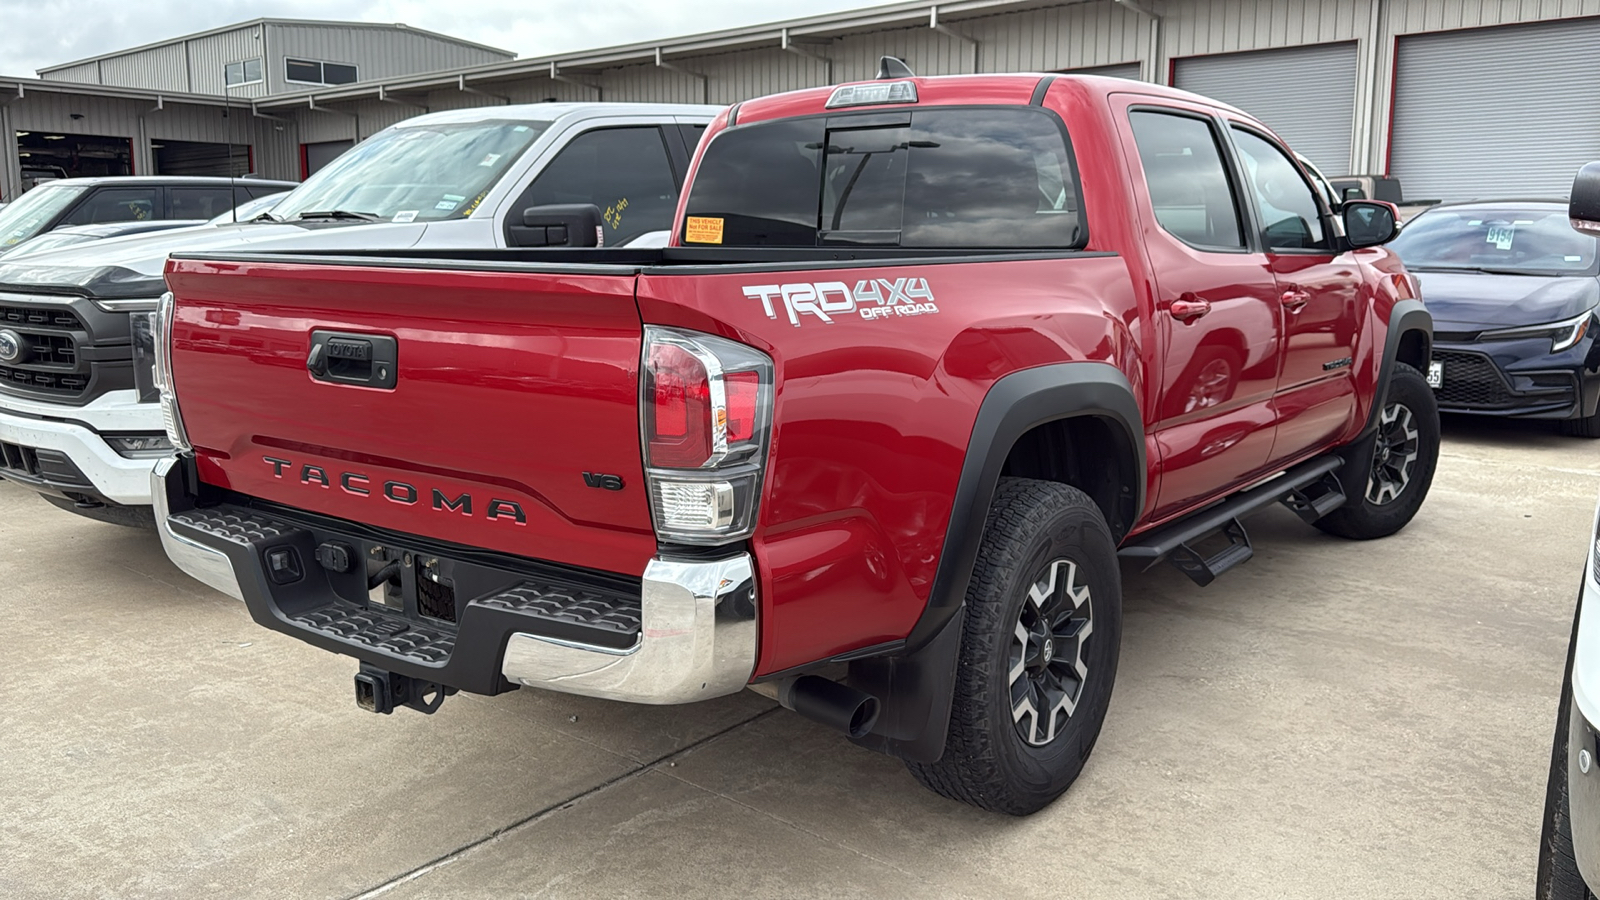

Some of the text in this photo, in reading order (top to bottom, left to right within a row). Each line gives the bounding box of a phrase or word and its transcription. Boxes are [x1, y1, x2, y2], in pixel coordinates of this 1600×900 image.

[1489, 227, 1512, 243] 9154
[742, 277, 935, 327] TRD 4X4
[859, 302, 939, 320] OFF ROAD
[328, 342, 365, 358] TOYOTA
[263, 455, 527, 526] TACOMA
[582, 471, 626, 491] V6
